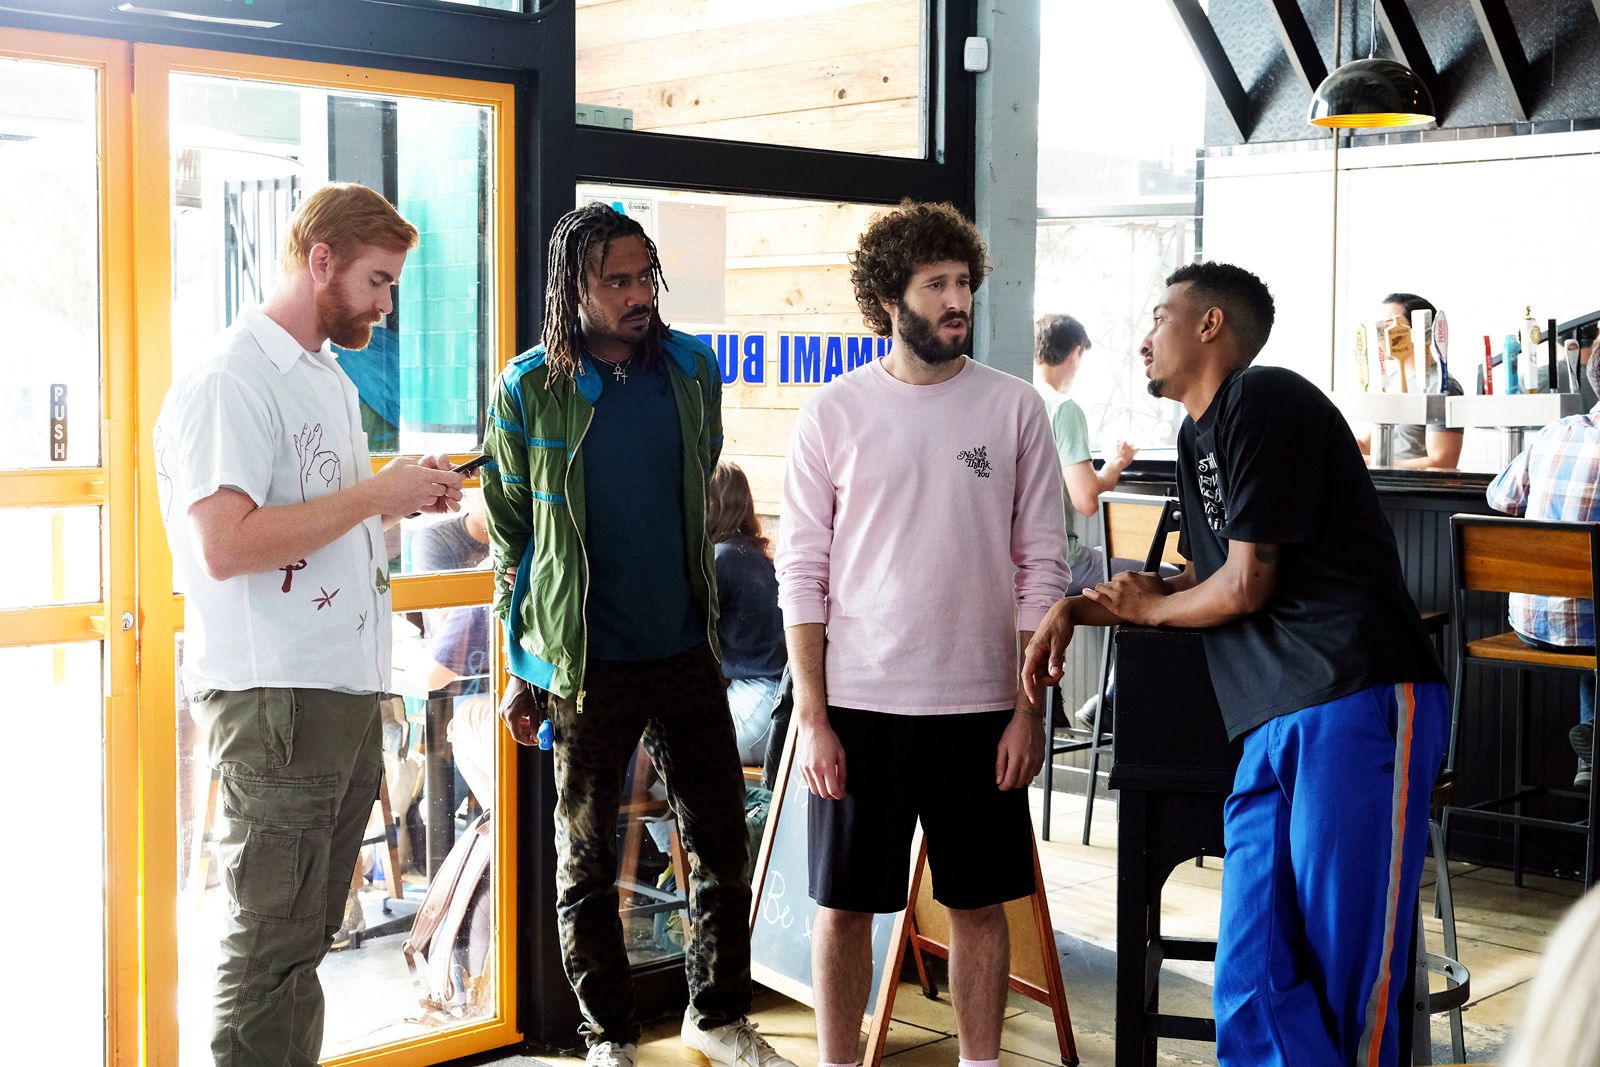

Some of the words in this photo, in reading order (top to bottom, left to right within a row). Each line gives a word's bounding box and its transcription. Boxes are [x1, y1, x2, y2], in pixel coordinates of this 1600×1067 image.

[54, 386, 65, 459] PUSH
[956, 450, 975, 461] No
[964, 456, 993, 471] Thank
[974, 468, 991, 478] You
[763, 870, 795, 929] Be
